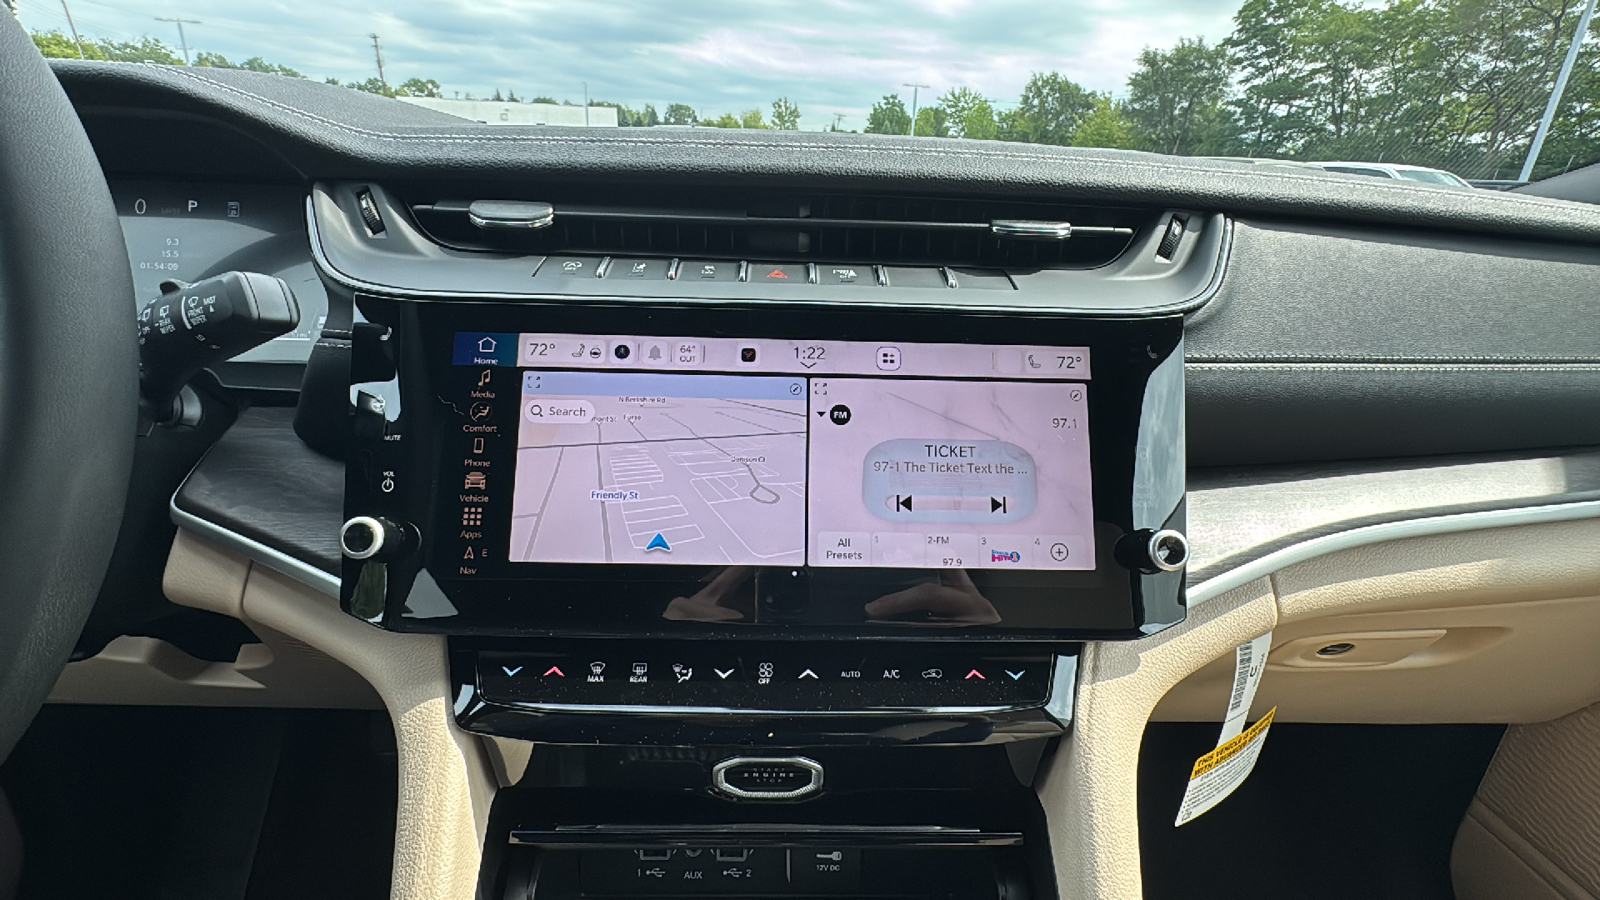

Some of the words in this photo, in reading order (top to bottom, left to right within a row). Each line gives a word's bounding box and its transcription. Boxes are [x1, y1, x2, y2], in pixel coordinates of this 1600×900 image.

[134, 198, 147, 215] 0
[187, 199, 198, 213] P
[166, 238, 179, 246] 9.3
[161, 250, 179, 258] 15.5
[139, 262, 179, 271] 01:54:09
[203, 295, 216, 305] MIST
[187, 306, 204, 318] FRONT
[189, 314, 207, 326] WIPER
[793, 346, 826, 360] 1:22
[473, 357, 499, 365] Home
[679, 355, 697, 363] OUT
[470, 389, 496, 399] Media
[656, 396, 667, 404] Rd
[549, 405, 587, 418] Search
[833, 411, 848, 419] FM
[1052, 417, 1078, 429] 97.1
[462, 424, 498, 433] Comfort
[383, 434, 402, 442] MUTE
[924, 444, 977, 458] TICKET
[464, 459, 491, 468] Phone
[873, 461, 900, 472] 97-1
[903, 461, 926, 473] The
[928, 461, 965, 474] Ticket
[966, 462, 993, 474] Text
[995, 463, 1015, 475] the
[459, 494, 489, 503] Vehicle
[590, 490, 627, 501] Friendly
[629, 491, 639, 500] St
[460, 530, 482, 540] Apps
[837, 537, 851, 548] All
[927, 536, 950, 545] 2-FM
[981, 536, 987, 546] 3
[1034, 537, 1041, 546] 4
[481, 548, 488, 557] E
[826, 550, 863, 561] Presets
[942, 558, 963, 567] 97.9
[459, 566, 477, 575] Nav
[840, 670, 861, 679] AUTO
[883, 668, 901, 679] A/C
[587, 675, 604, 683] MAX
[629, 675, 648, 683] REAR
[637, 868, 642, 877] 1
[816, 864, 829, 872] 12V
[829, 864, 841, 872] DC
[683, 871, 703, 880] AUX
[745, 868, 752, 878] 2
